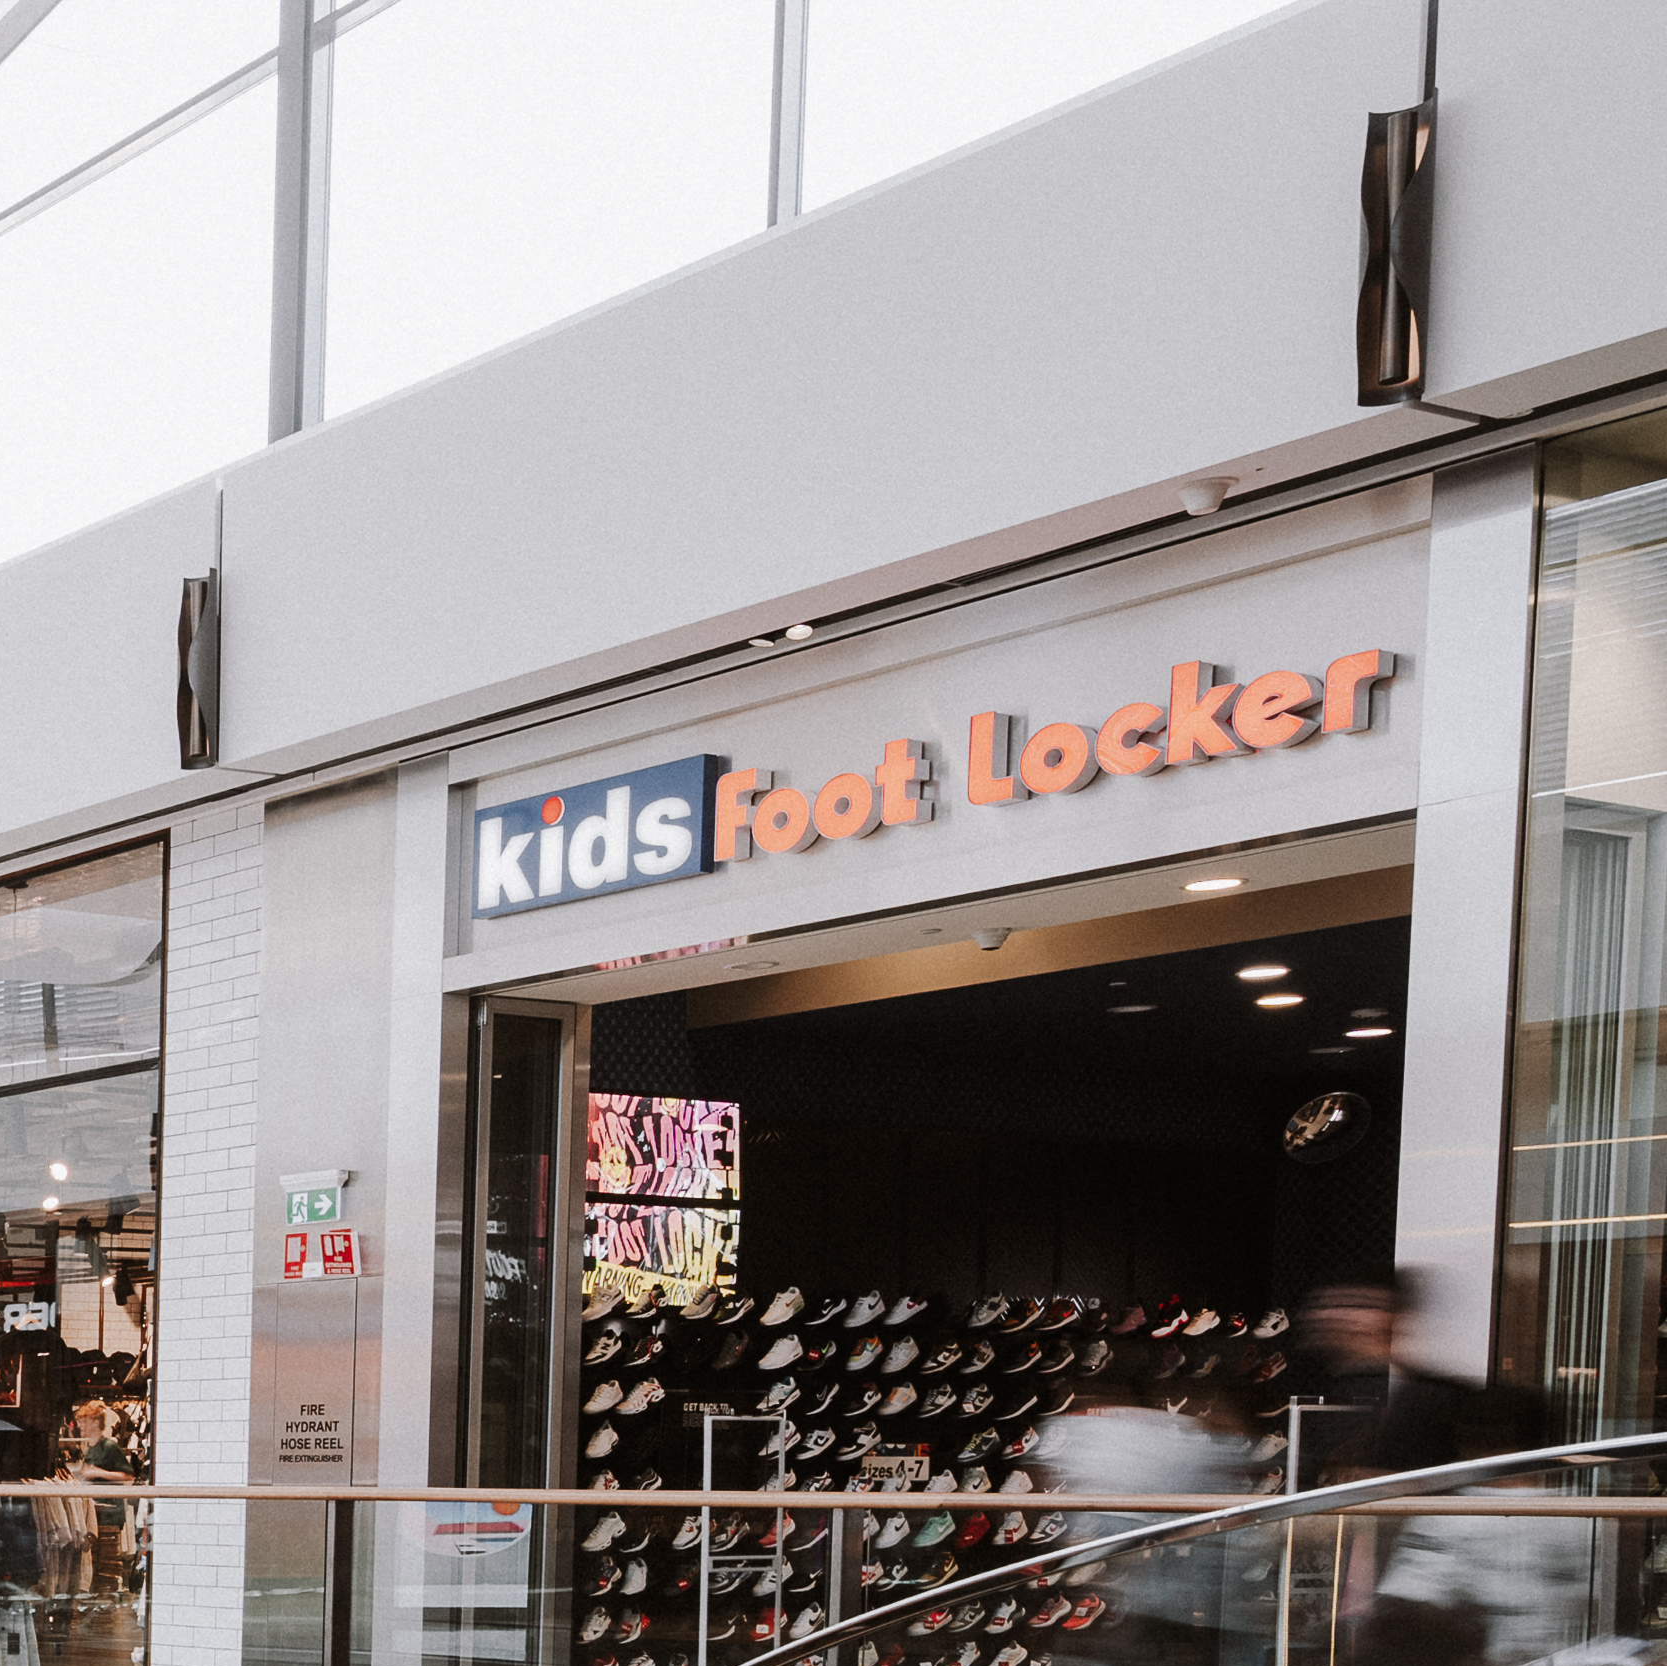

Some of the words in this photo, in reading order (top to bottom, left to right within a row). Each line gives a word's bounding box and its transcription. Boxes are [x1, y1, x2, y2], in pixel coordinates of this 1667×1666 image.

[477, 787, 692, 911] kids
[967, 648, 1389, 806] Locker
[300, 1404, 325, 1416] FIRE
[286, 1421, 339, 1433] HYDRANT
[280, 1438, 311, 1450] HOSE
[314, 1437, 344, 1449] REEL
[279, 1454, 294, 1463] FIRE
[294, 1454, 343, 1463] EXTINGUISHER
